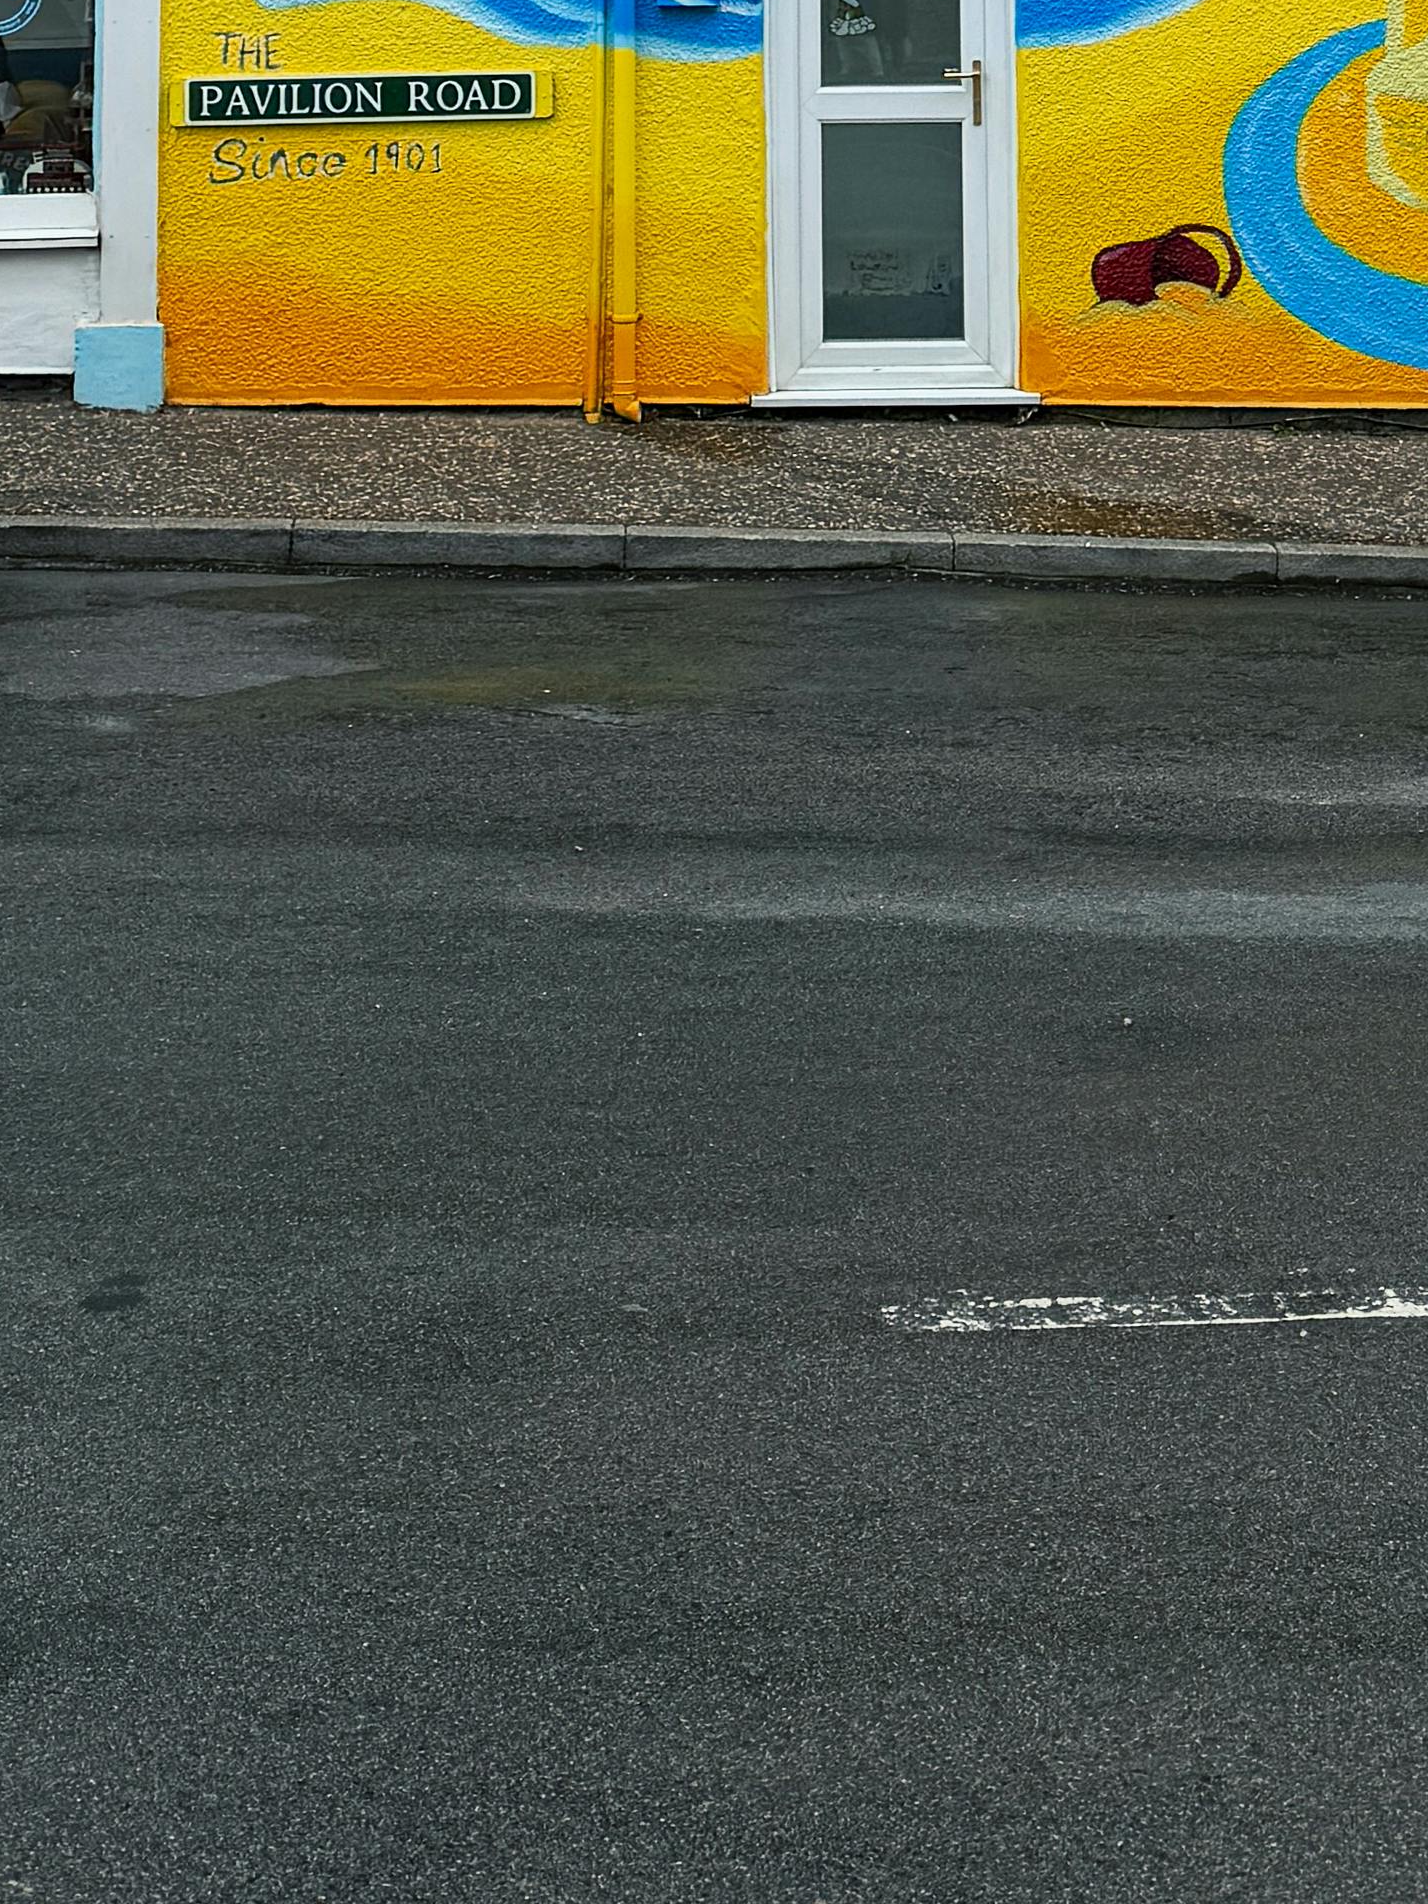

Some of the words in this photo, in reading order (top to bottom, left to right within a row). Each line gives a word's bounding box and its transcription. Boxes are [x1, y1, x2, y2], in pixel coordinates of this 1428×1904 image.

[212, 32, 282, 70] THE
[199, 81, 383, 117] PAVILION
[408, 79, 522, 111] ROAD
[208, 136, 348, 184] Since
[365, 141, 442, 175] 1901
